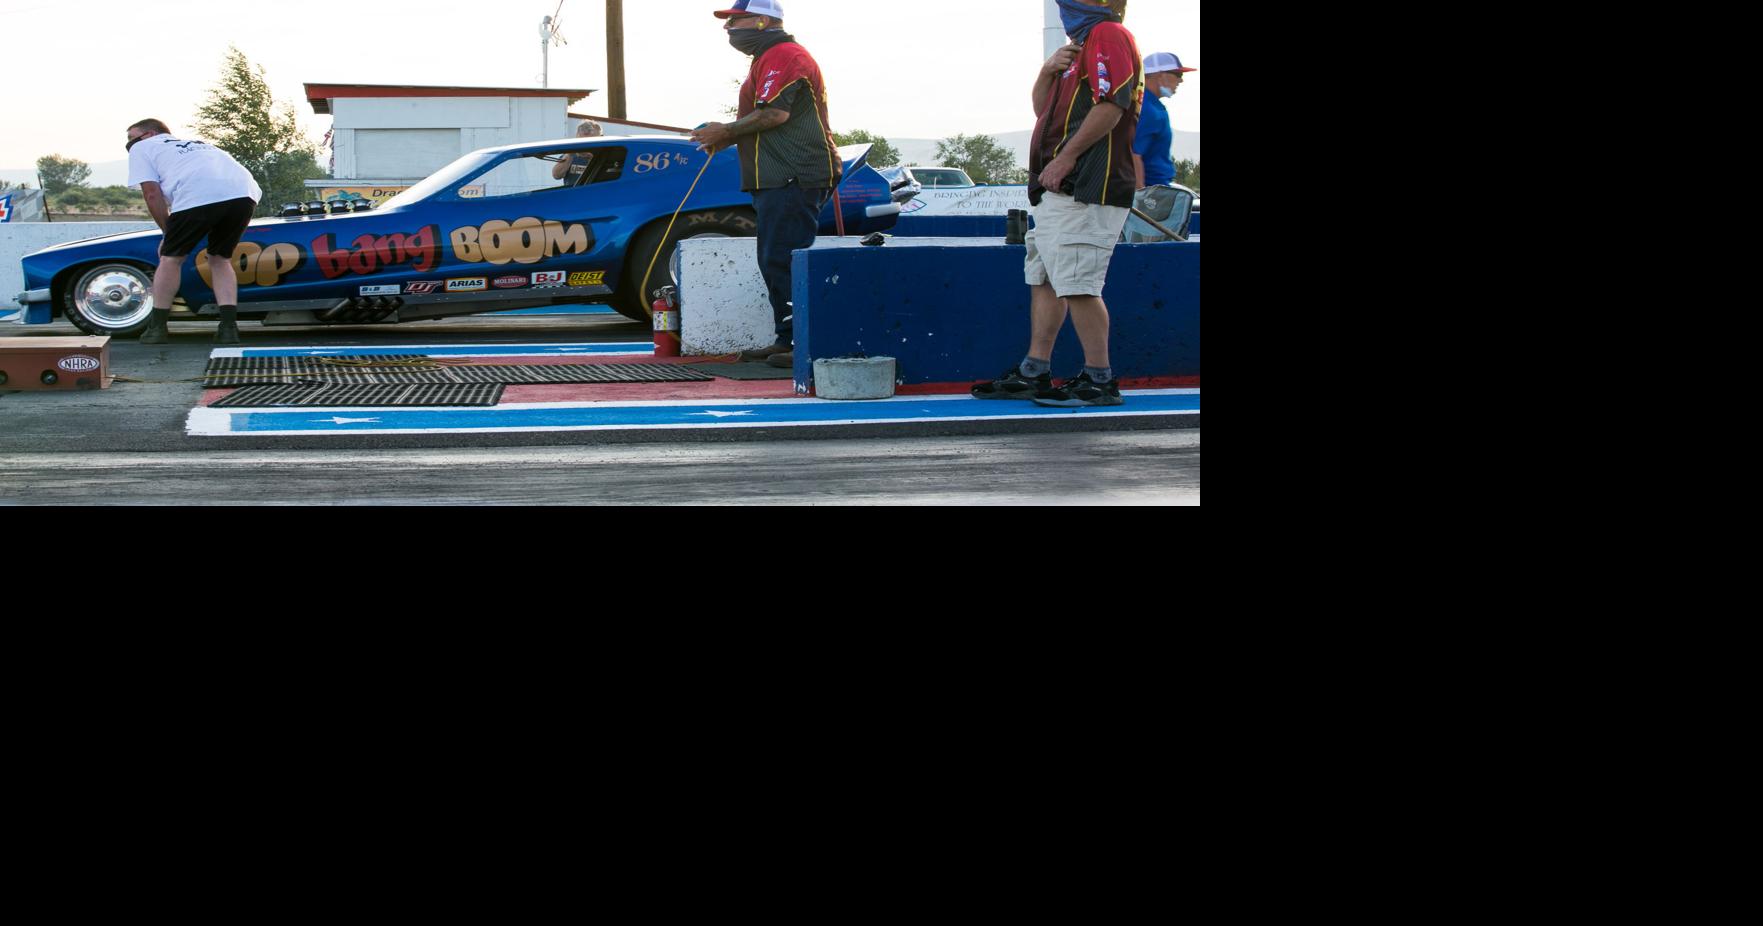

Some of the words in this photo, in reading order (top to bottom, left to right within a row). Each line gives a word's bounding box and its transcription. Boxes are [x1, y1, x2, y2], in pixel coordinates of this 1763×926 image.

[633, 151, 670, 174] 86
[957, 201, 972, 209] TO
[976, 201, 993, 209] THE
[311, 224, 442, 279] bang
[450, 216, 595, 264] BOOM
[449, 279, 484, 288] ARIAS
[64, 358, 93, 369] NHRA
